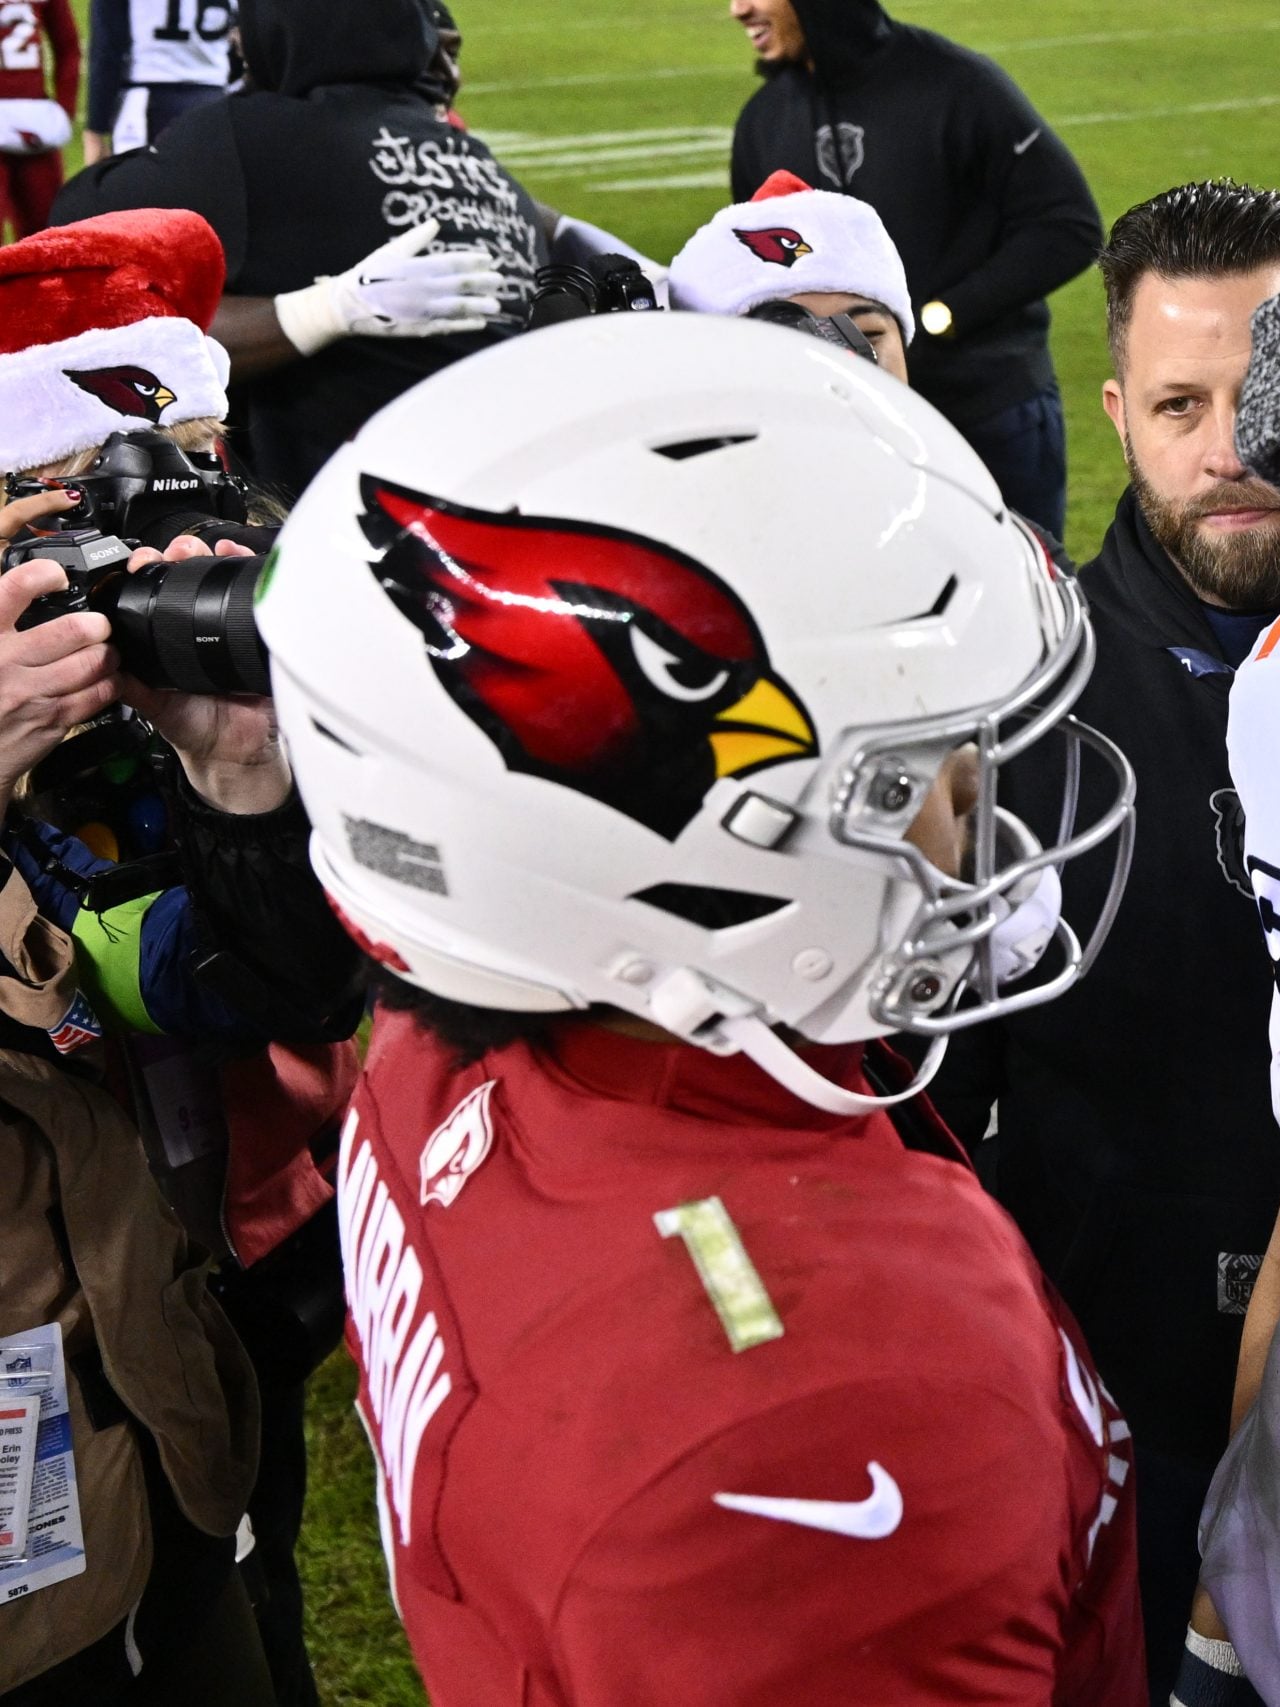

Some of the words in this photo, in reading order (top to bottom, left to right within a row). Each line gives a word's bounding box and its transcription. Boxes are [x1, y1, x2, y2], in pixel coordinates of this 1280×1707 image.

[153, 478, 199, 492] Nikon
[89, 545, 121, 561] SONY
[195, 635, 220, 643] SONY
[653, 1196, 785, 1353] 1
[2, 1444, 21, 1454] Erin
[0, 1455, 20, 1464] oley
[8, 1584, 29, 1598] 5876
